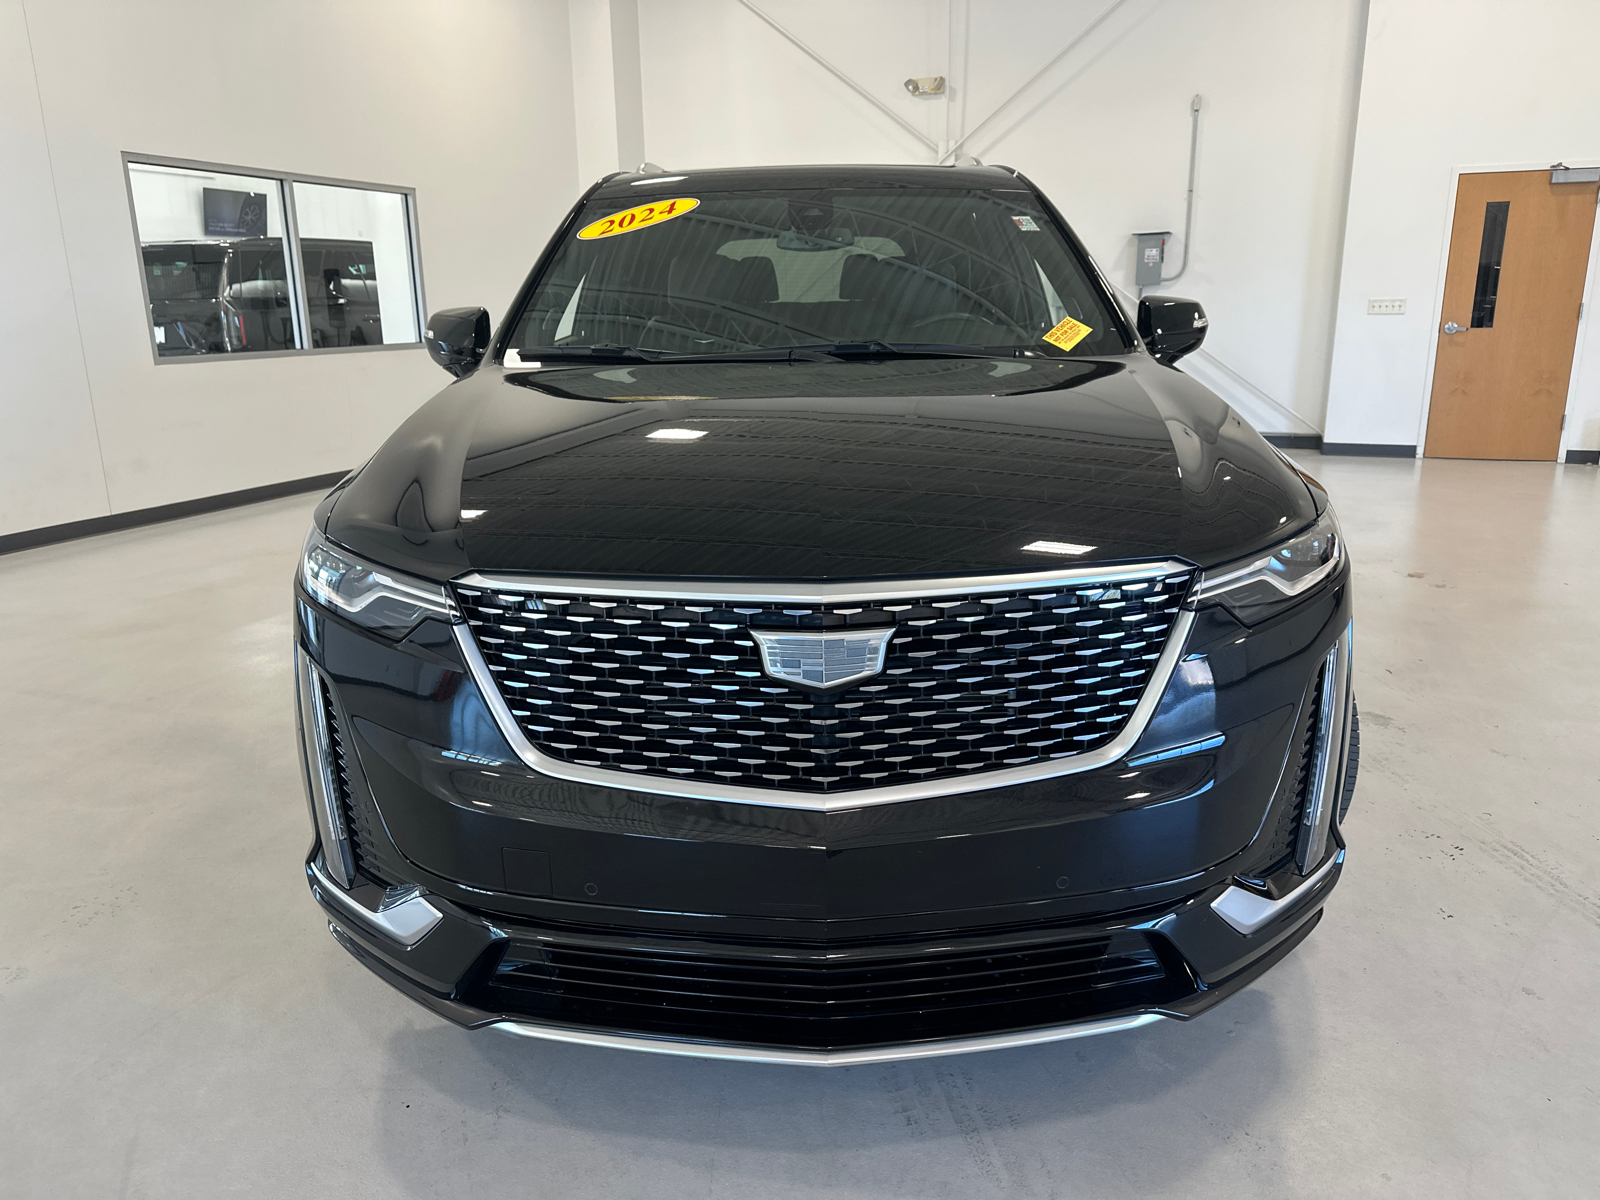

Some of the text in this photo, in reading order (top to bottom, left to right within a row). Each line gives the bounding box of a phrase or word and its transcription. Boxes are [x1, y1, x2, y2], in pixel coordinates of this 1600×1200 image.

[598, 200, 677, 237] 2024
[1045, 331, 1058, 340] THIS
[1054, 318, 1073, 332] VEHICLE
[1060, 329, 1069, 337] FOR
[1067, 322, 1077, 331] SALE
